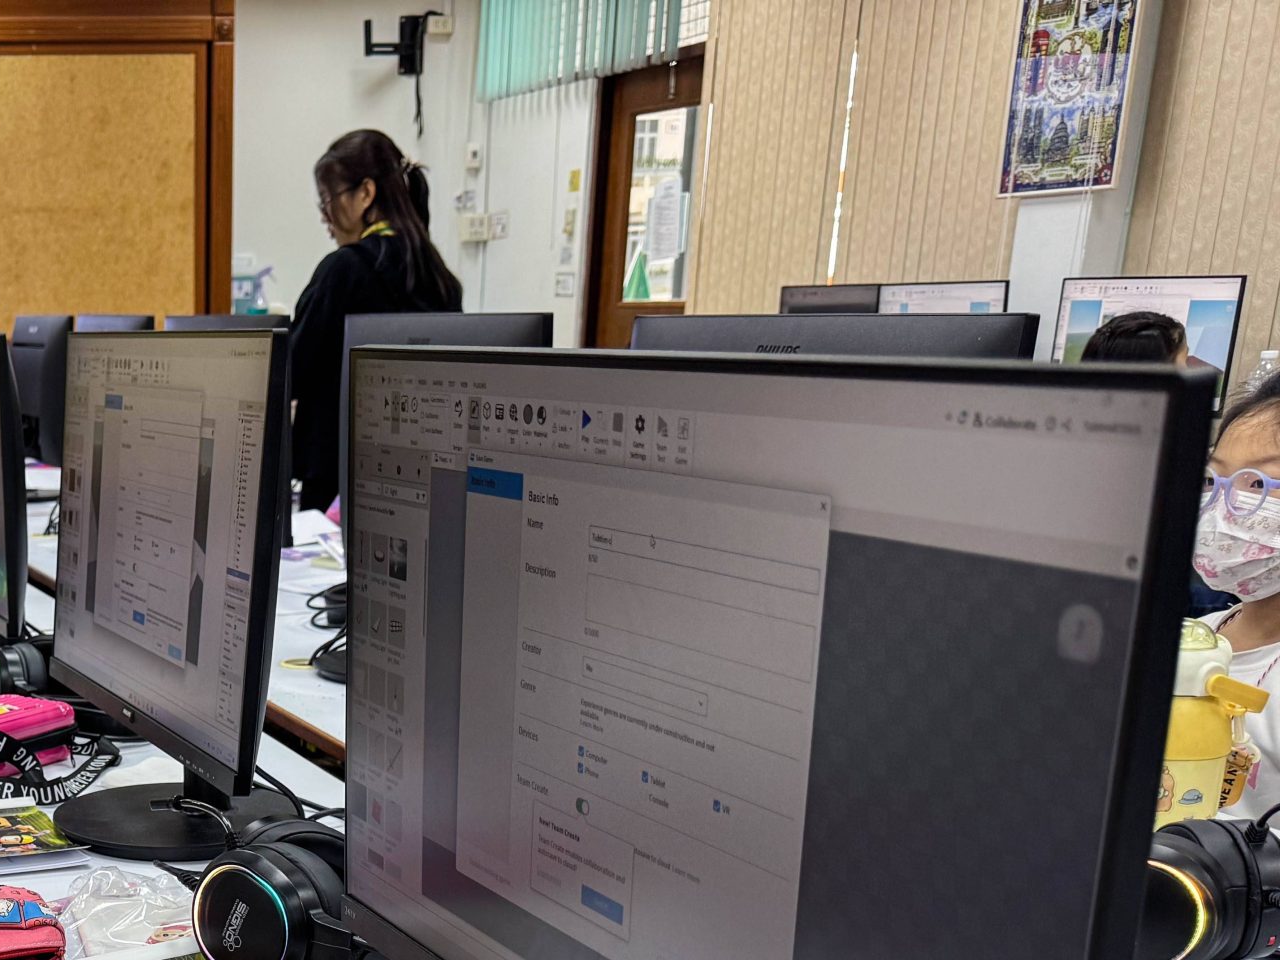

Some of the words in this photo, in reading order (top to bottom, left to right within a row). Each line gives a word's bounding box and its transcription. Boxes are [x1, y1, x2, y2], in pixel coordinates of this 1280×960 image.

[528, 490, 545, 505] Basic
[546, 494, 559, 507] Info
[527, 518, 544, 530] Name
[525, 562, 556, 578] Description
[521, 641, 542, 656] Creator
[520, 679, 537, 693] Genre
[518, 726, 539, 743] Devices
[627, 710, 648, 729] currently
[649, 720, 663, 732] under
[663, 724, 694, 746] construction
[695, 738, 705, 749] and
[585, 749, 608, 764] Computer
[585, 767, 599, 779] Phone
[516, 773, 531, 788] Team
[531, 779, 549, 795] Create
[648, 794, 669, 809] Console
[550, 822, 563, 835] Team
[563, 827, 580, 842] Create
[550, 838, 564, 852] Create
